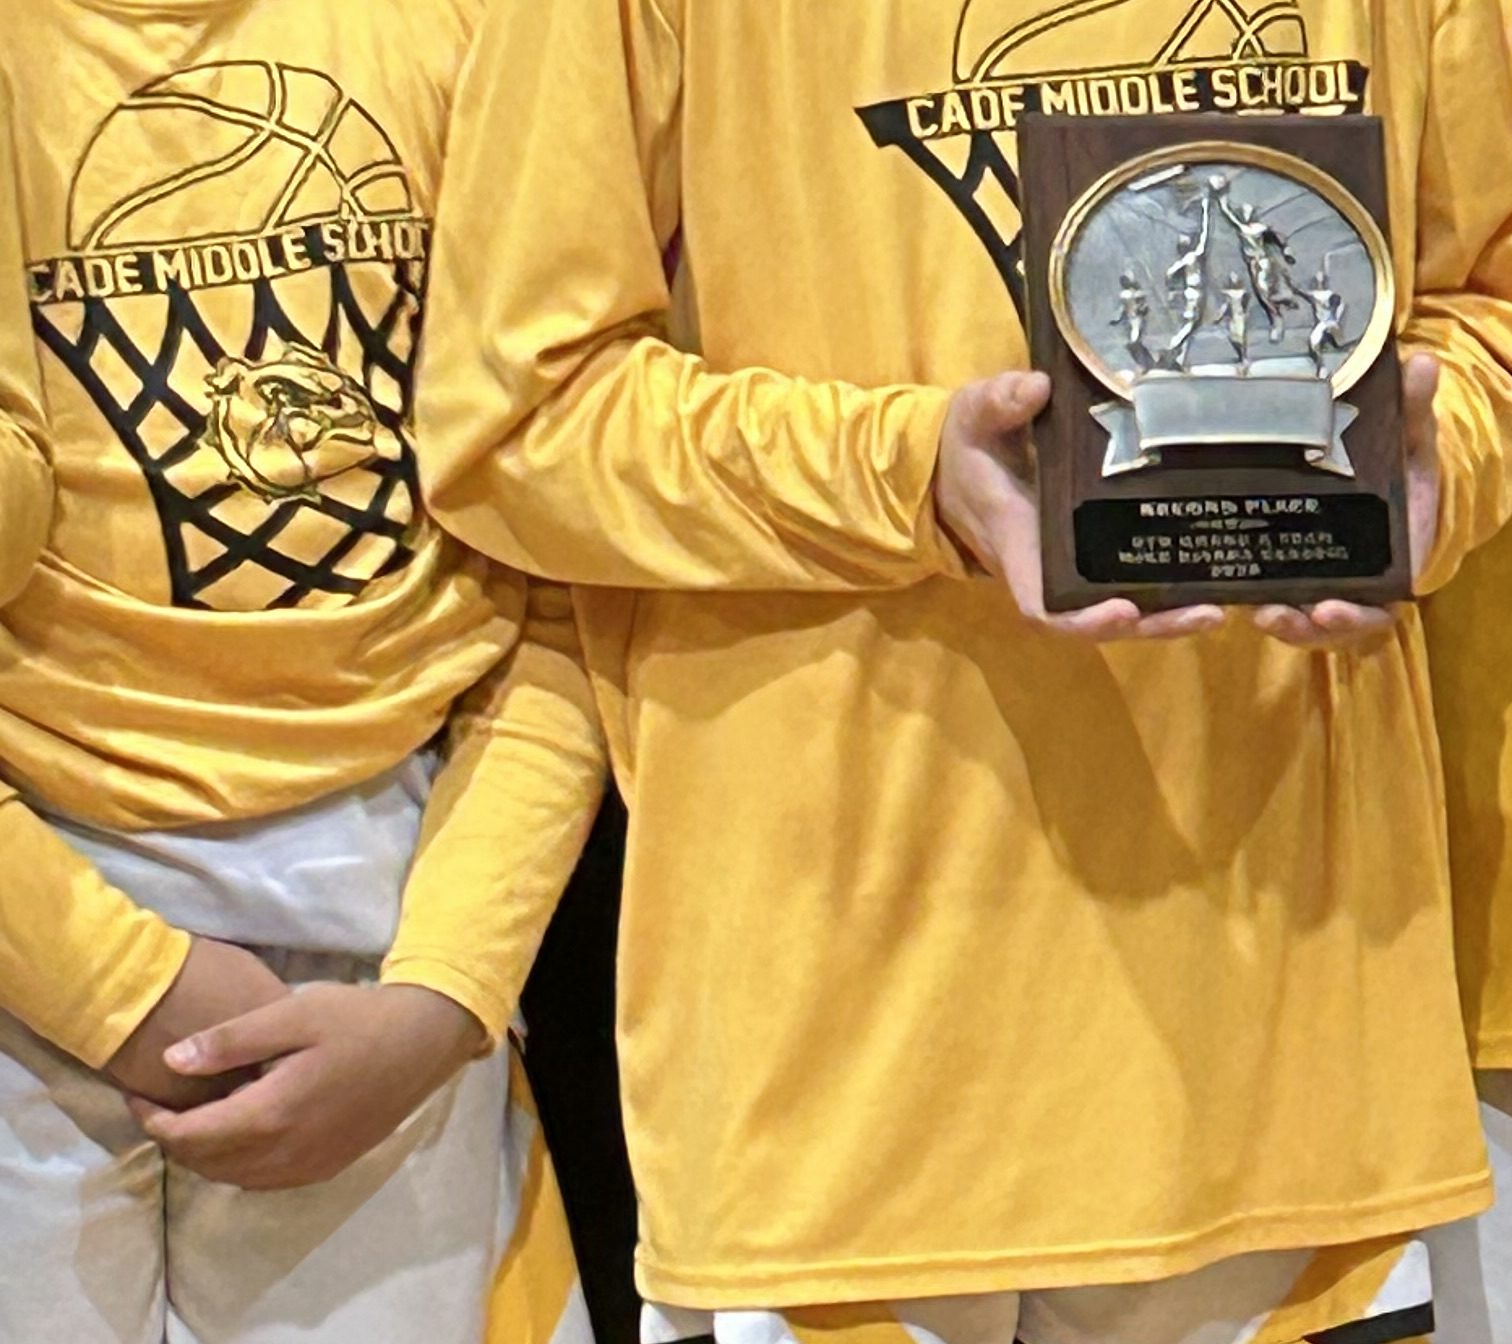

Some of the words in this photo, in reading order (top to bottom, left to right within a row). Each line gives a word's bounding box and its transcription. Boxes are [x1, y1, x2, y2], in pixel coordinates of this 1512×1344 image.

[905, 88, 1025, 140] CADE
[1039, 69, 1201, 117] MIDDLE
[1210, 60, 1359, 109] SCHOOL
[28, 252, 144, 303] CADE
[152, 228, 313, 293] MIDDLE
